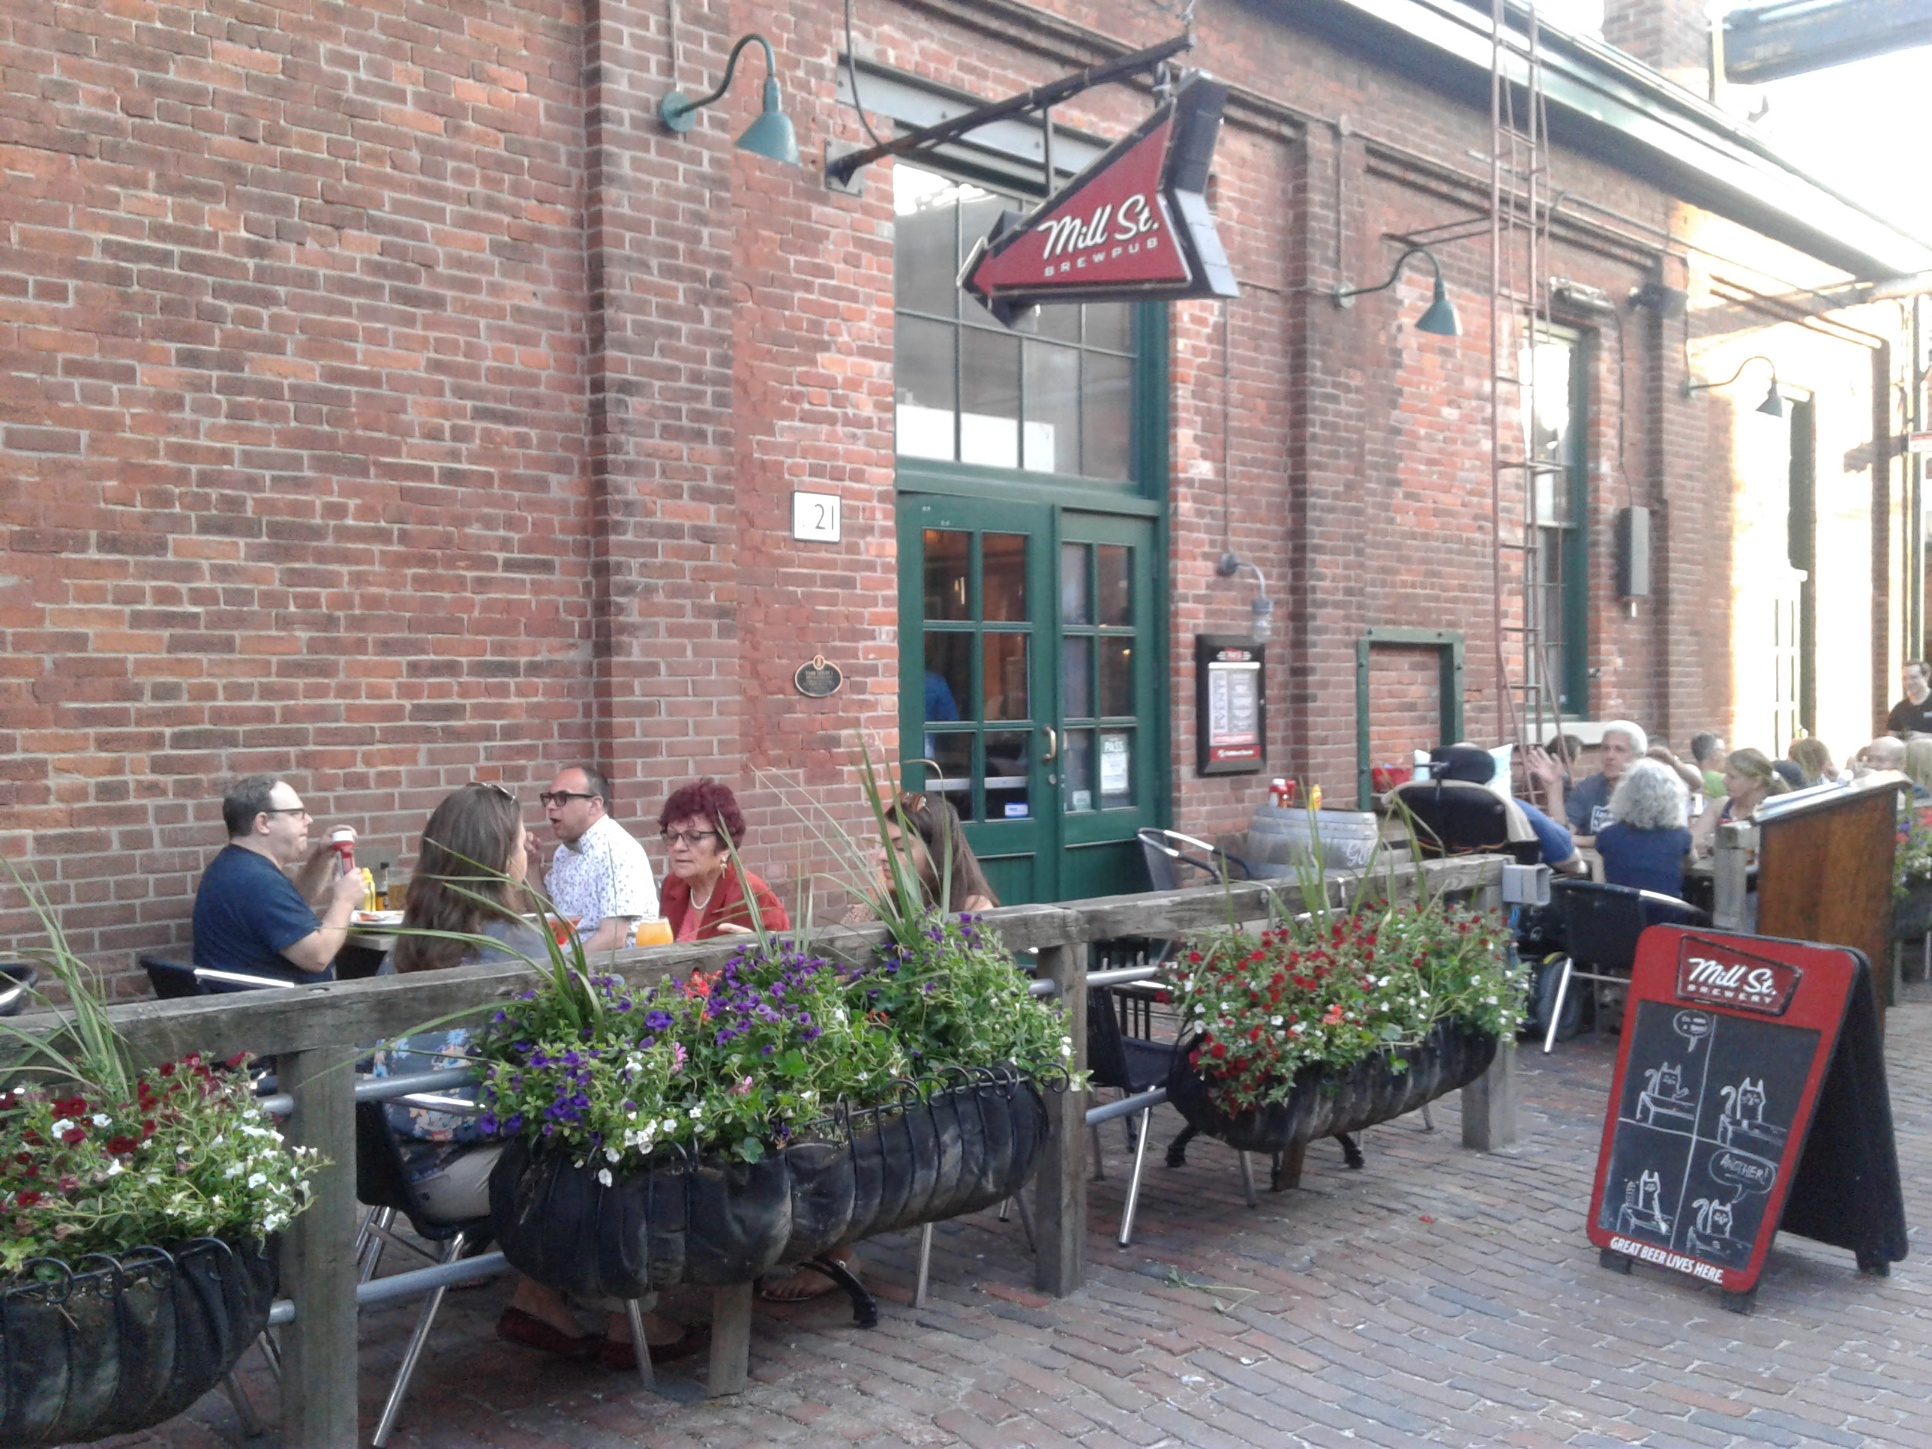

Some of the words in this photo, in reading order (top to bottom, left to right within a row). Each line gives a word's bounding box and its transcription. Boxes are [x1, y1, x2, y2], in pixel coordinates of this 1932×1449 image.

[1037, 203, 1112, 260] Mill
[1114, 194, 1159, 240] St.
[1044, 237, 1158, 277] BREWPUB
[815, 503, 834, 530] 21
[1104, 741, 1124, 752] PASS
[1687, 984, 1772, 1004] BREWERY
[1688, 957, 1748, 987] Mill
[1743, 968, 1777, 995] St.
[1610, 1236, 1642, 1256] GREAT
[1640, 1245, 1667, 1265] BEER
[1666, 1253, 1695, 1273] LIVES
